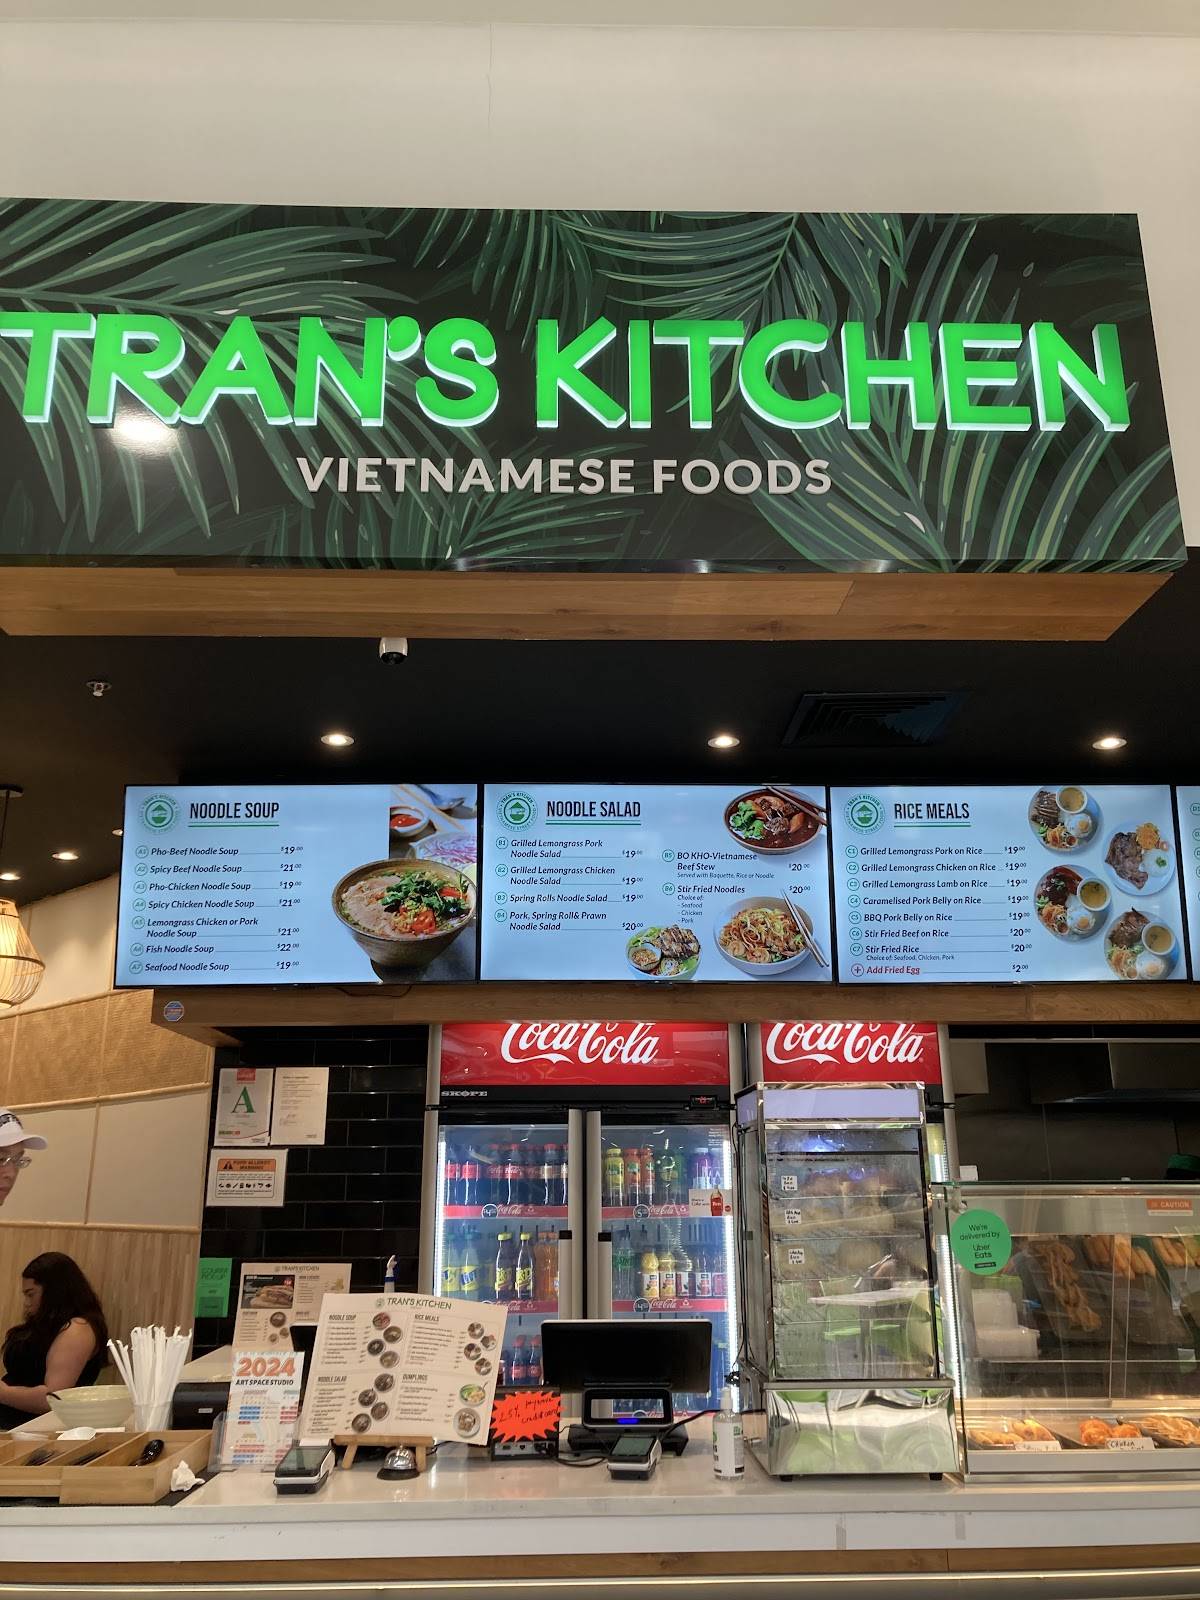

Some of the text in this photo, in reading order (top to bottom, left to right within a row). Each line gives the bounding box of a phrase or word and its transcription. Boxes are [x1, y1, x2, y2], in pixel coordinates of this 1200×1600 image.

[0, 311, 1129, 432] TRAN'S KITCHEN
[296, 457, 832, 496] VIETNAMESE FOODS
[189, 802, 242, 819] NOODLE
[244, 802, 280, 818] SOUP
[546, 801, 641, 817] NOODLE SALAD
[893, 802, 970, 819] RICE MEALS
[510, 839, 603, 849] Grilled Lemongrass Pork
[151, 848, 189, 857] Pho-Beef
[189, 847, 219, 855] Noodle
[219, 847, 239, 857] Soup
[510, 850, 562, 858] Noodle Salad
[677, 852, 758, 860] BO KHO-Vietnamese
[860, 847, 887, 855] Grilled
[888, 847, 934, 857] Lemongrass
[934, 847, 953, 855] Pork
[149, 865, 172, 875] Spicy
[173, 865, 191, 873] Beef
[191, 865, 222, 873] Noodle
[222, 864, 242, 874] Soup
[510, 866, 616, 876] Grilled Lemongrass Chicken
[677, 863, 696, 871] Beef
[696, 863, 716, 871] Stew
[861, 864, 888, 872] Grilled
[889, 863, 935, 873] Lemongrass
[936, 863, 967, 872] Chicken
[979, 863, 996, 871] Rice
[510, 877, 538, 885] Noodle
[539, 877, 562, 885] Salad
[862, 880, 889, 888] Grilled
[889, 880, 935, 889] Lemongrass
[936, 880, 958, 888] Lamb
[149, 883, 200, 891] Pho-Chicken
[201, 882, 230, 890] Noodle
[231, 882, 251, 891] Soup
[677, 885, 692, 893] Stir
[692, 885, 713, 893] Fried
[714, 885, 745, 893] Noodles
[148, 900, 170, 909] Spicy
[171, 900, 203, 908] Chicken
[204, 900, 233, 908] Noodle
[234, 899, 255, 909] Soup
[510, 894, 535, 904] Spring
[536, 894, 556, 902] Rolls
[557, 894, 584, 902] Noodle
[585, 894, 608, 902] Salad
[863, 896, 911, 905] Caramelised
[912, 896, 931, 904] Pork
[932, 896, 952, 906] Belly
[964, 896, 982, 904] Rice
[509, 911, 531, 920] Pork,
[532, 912, 557, 921] Spring
[581, 911, 607, 919] Prawn
[864, 913, 882, 922] BBQ
[883, 913, 902, 921] Pork
[903, 913, 923, 923] Belly
[936, 913, 953, 921] Rice
[147, 918, 194, 927] Lemongrass
[195, 918, 228, 926] Chicken
[239, 917, 259, 925] Pork
[509, 922, 537, 931] Noodle
[538, 922, 561, 931] Salad
[146, 930, 176, 938] Noodle
[176, 930, 197, 939] Soup
[864, 929, 879, 938] Stir
[880, 929, 900, 937] Fried
[901, 929, 920, 938] Beef
[932, 929, 949, 937] Rice
[145, 945, 163, 953] Fish
[164, 945, 193, 953] Noodle
[194, 945, 214, 954] Soup
[865, 945, 880, 953] Stir
[881, 945, 902, 953] Fried
[903, 945, 920, 953] Rice
[145, 963, 178, 972] Seafood
[178, 963, 208, 971] Noodle
[208, 962, 230, 972] Soup
[866, 965, 883, 974] Add
[884, 965, 905, 974] Fried
[906, 965, 921, 976] Egg
[231, 1086, 257, 1114] A
[1160, 1201, 1190, 1209] CAUTION
[959, 1231, 1001, 1241] delivered by
[972, 1243, 991, 1251] Uber
[974, 1251, 993, 1259] Eats
[387, 1297, 452, 1310] TRAN'S KITCHEN
[236, 1356, 296, 1377] 2024
